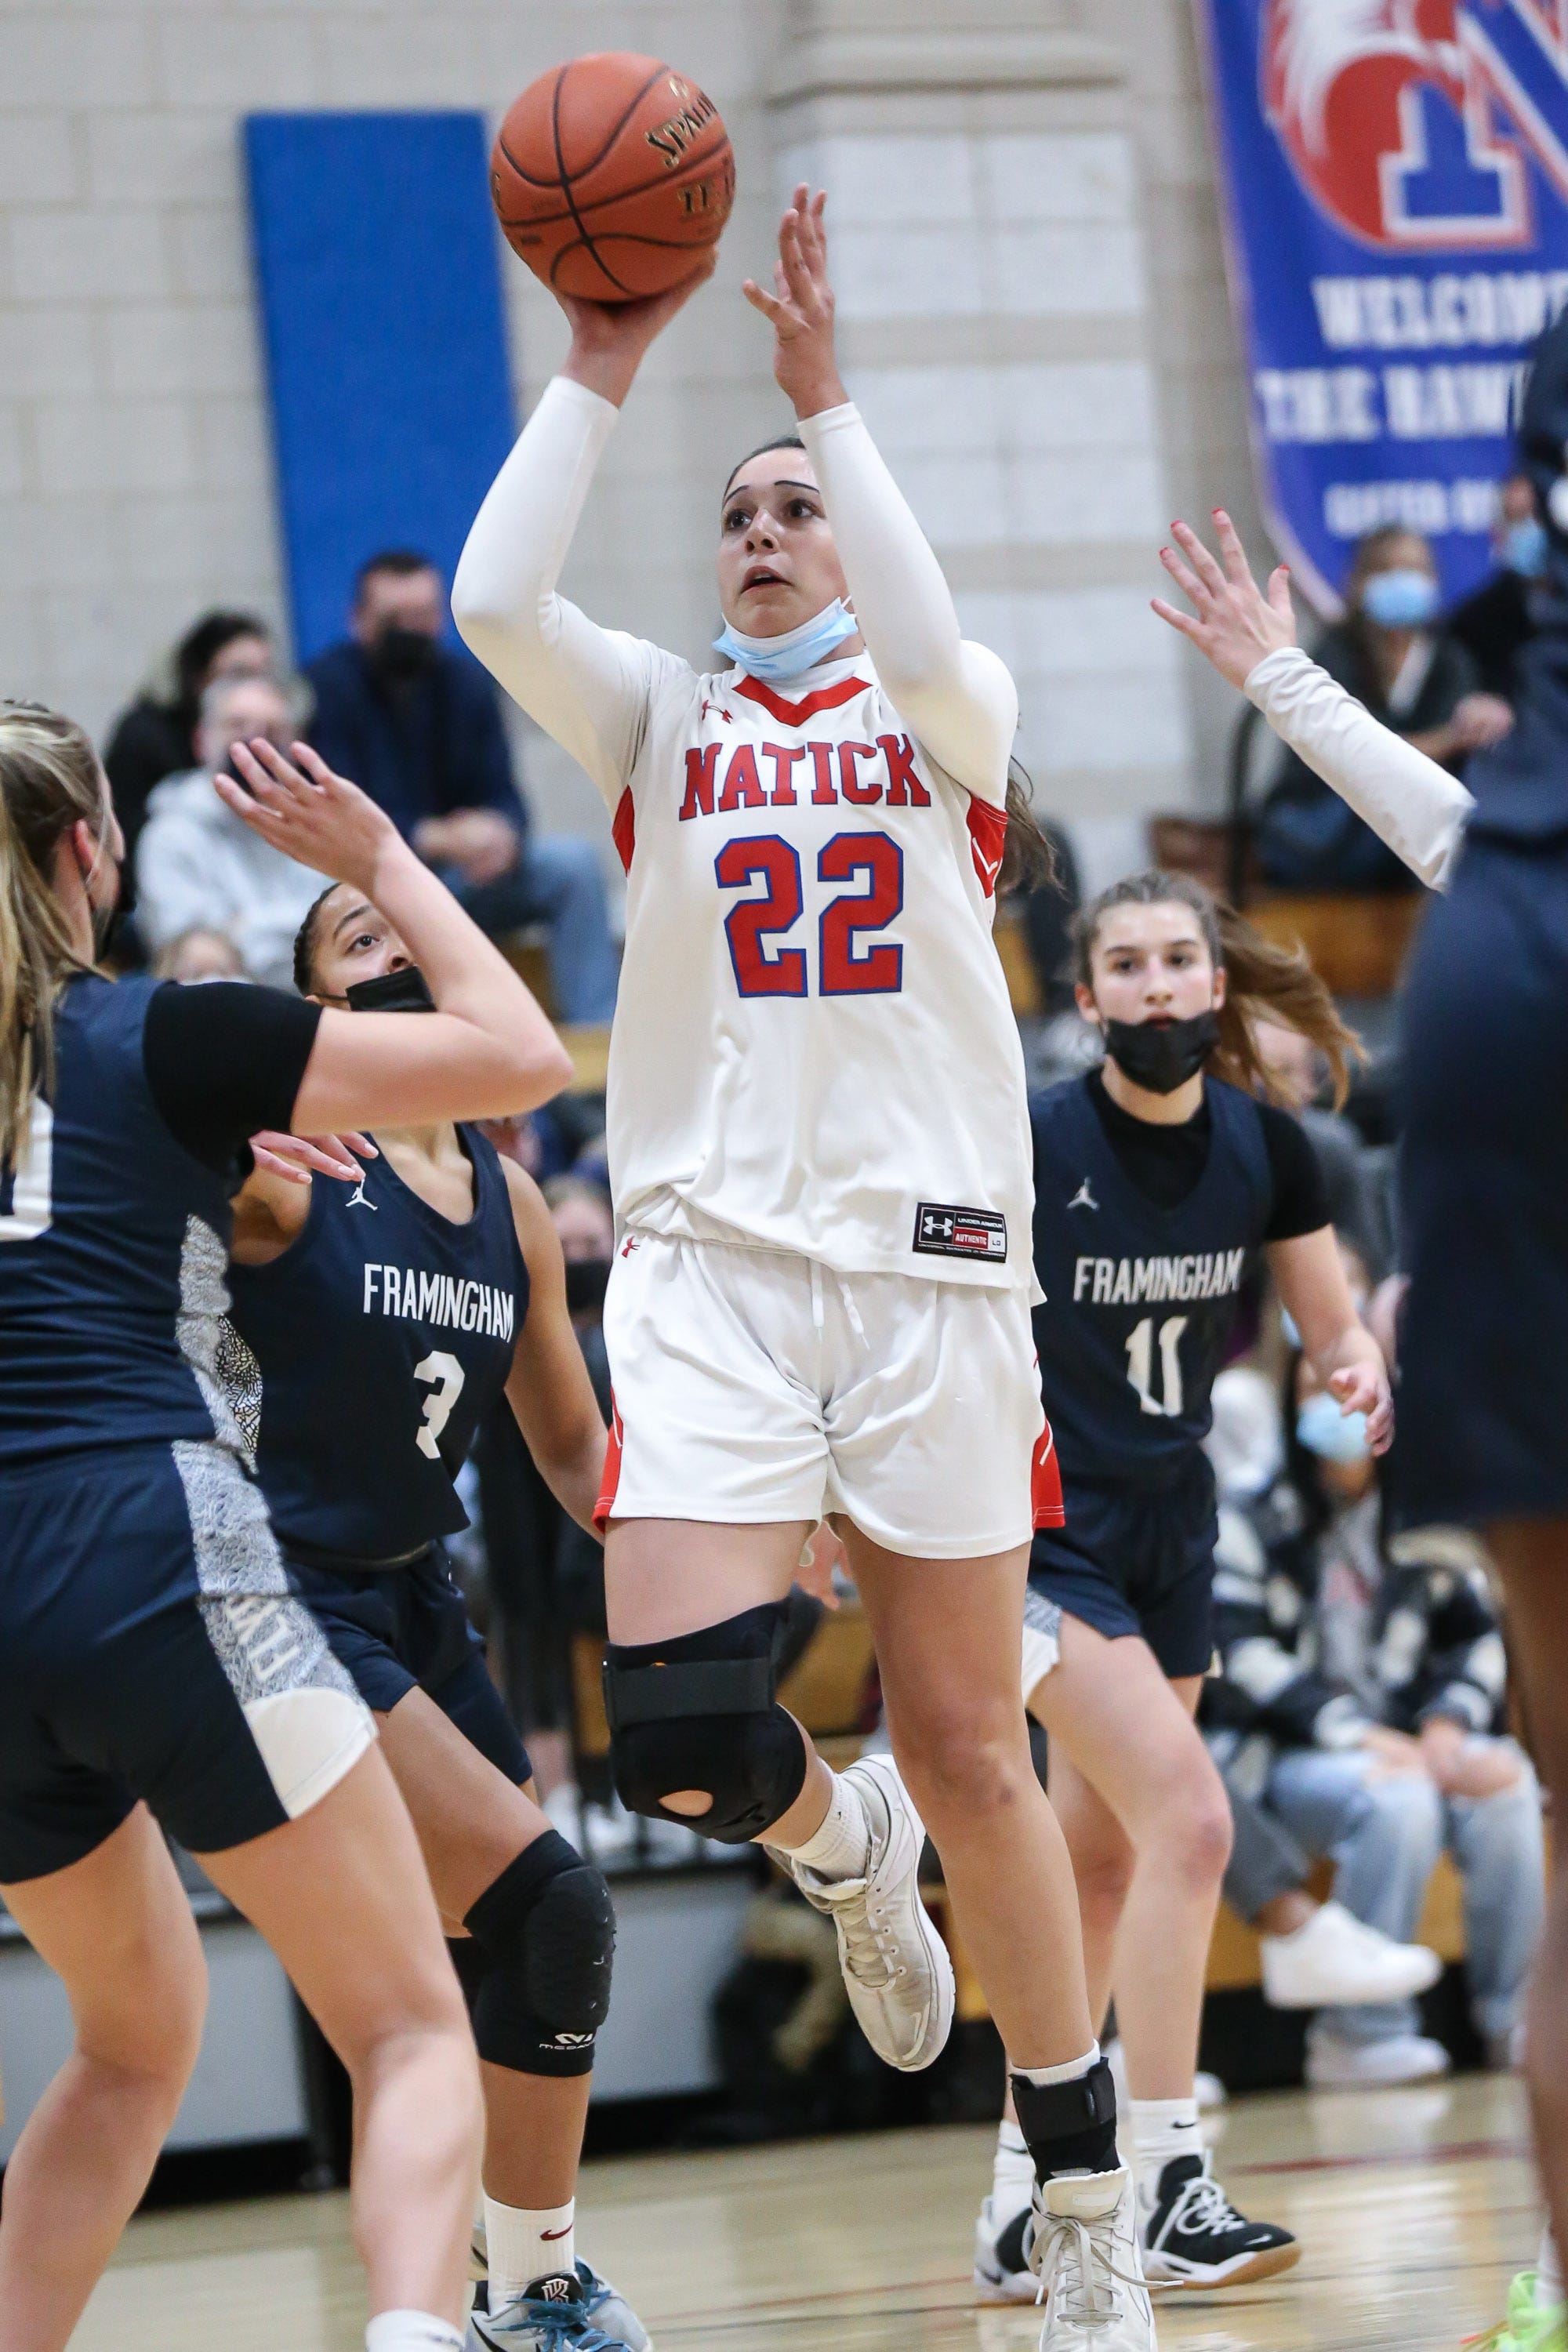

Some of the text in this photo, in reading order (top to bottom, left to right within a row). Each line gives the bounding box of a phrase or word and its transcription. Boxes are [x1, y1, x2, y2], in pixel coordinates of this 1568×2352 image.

[679, 733, 931, 822] NATICK
[714, 831, 904, 998] 22
[955, 1232, 988, 1246] AUTHENTIC
[1073, 1247, 1245, 1305] FRAMINGHAM
[363, 1262, 514, 1344] FRAMINGHAM
